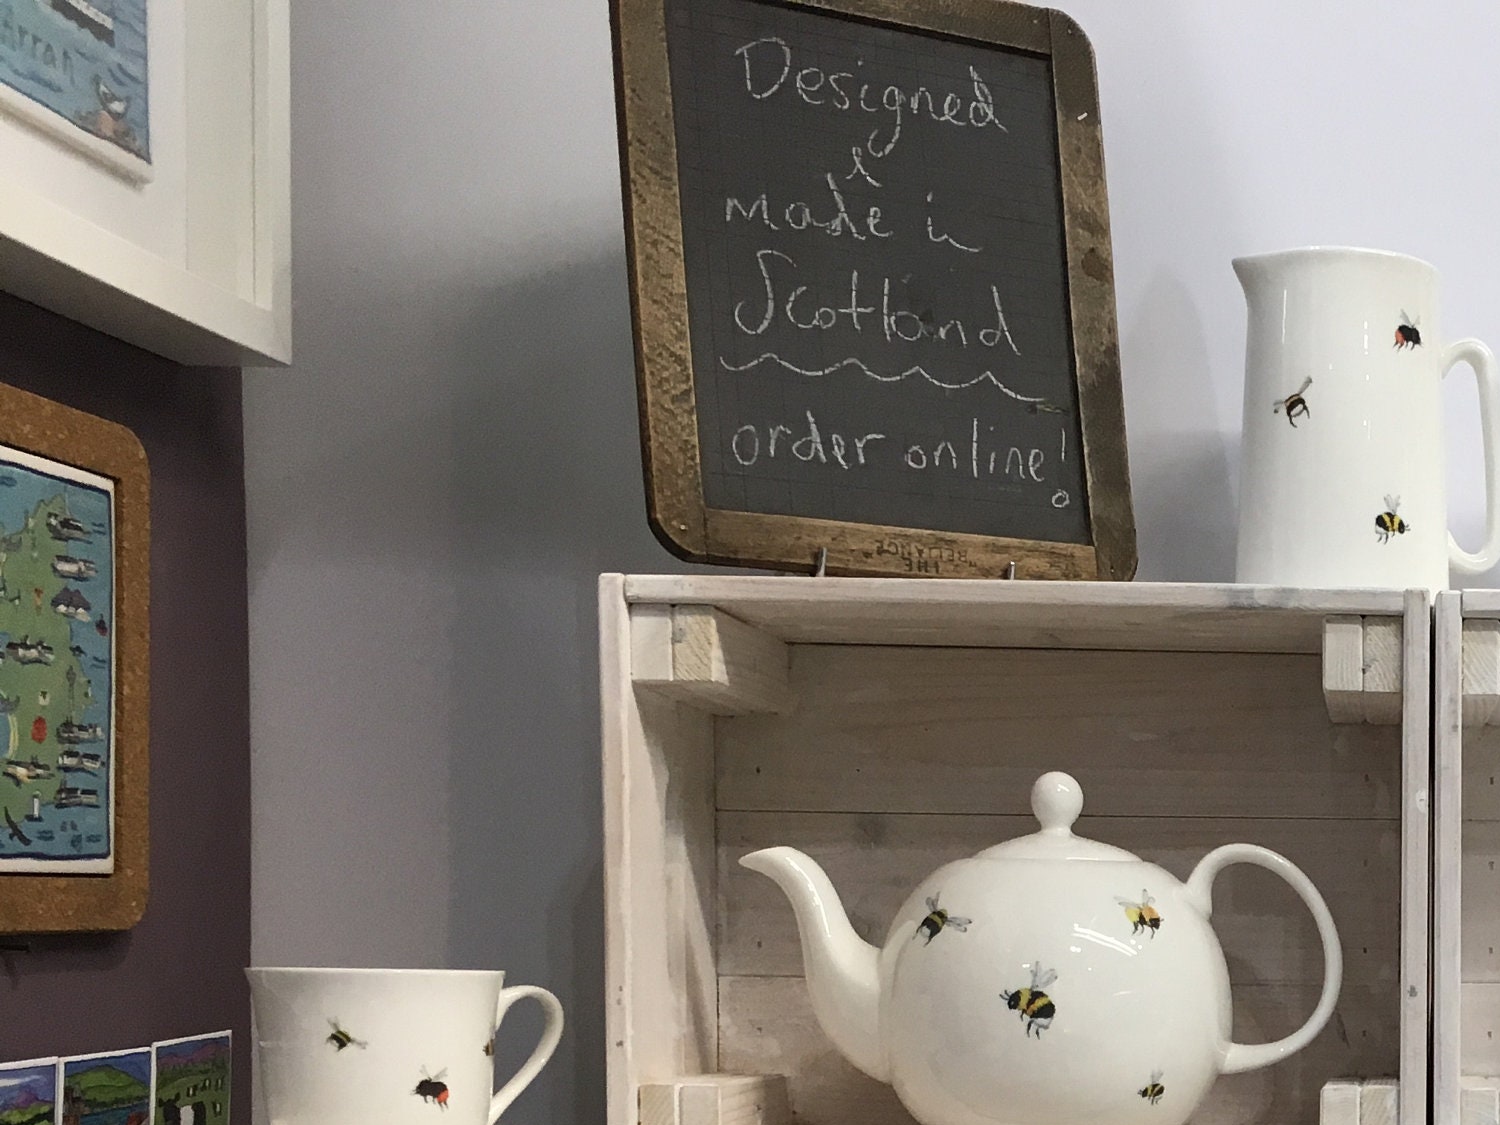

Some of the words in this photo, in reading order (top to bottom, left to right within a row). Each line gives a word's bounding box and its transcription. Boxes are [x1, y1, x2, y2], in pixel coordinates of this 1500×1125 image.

[734, 37, 1008, 157] Designed
[734, 249, 1021, 356] Scotland
[732, 410, 885, 469] order
